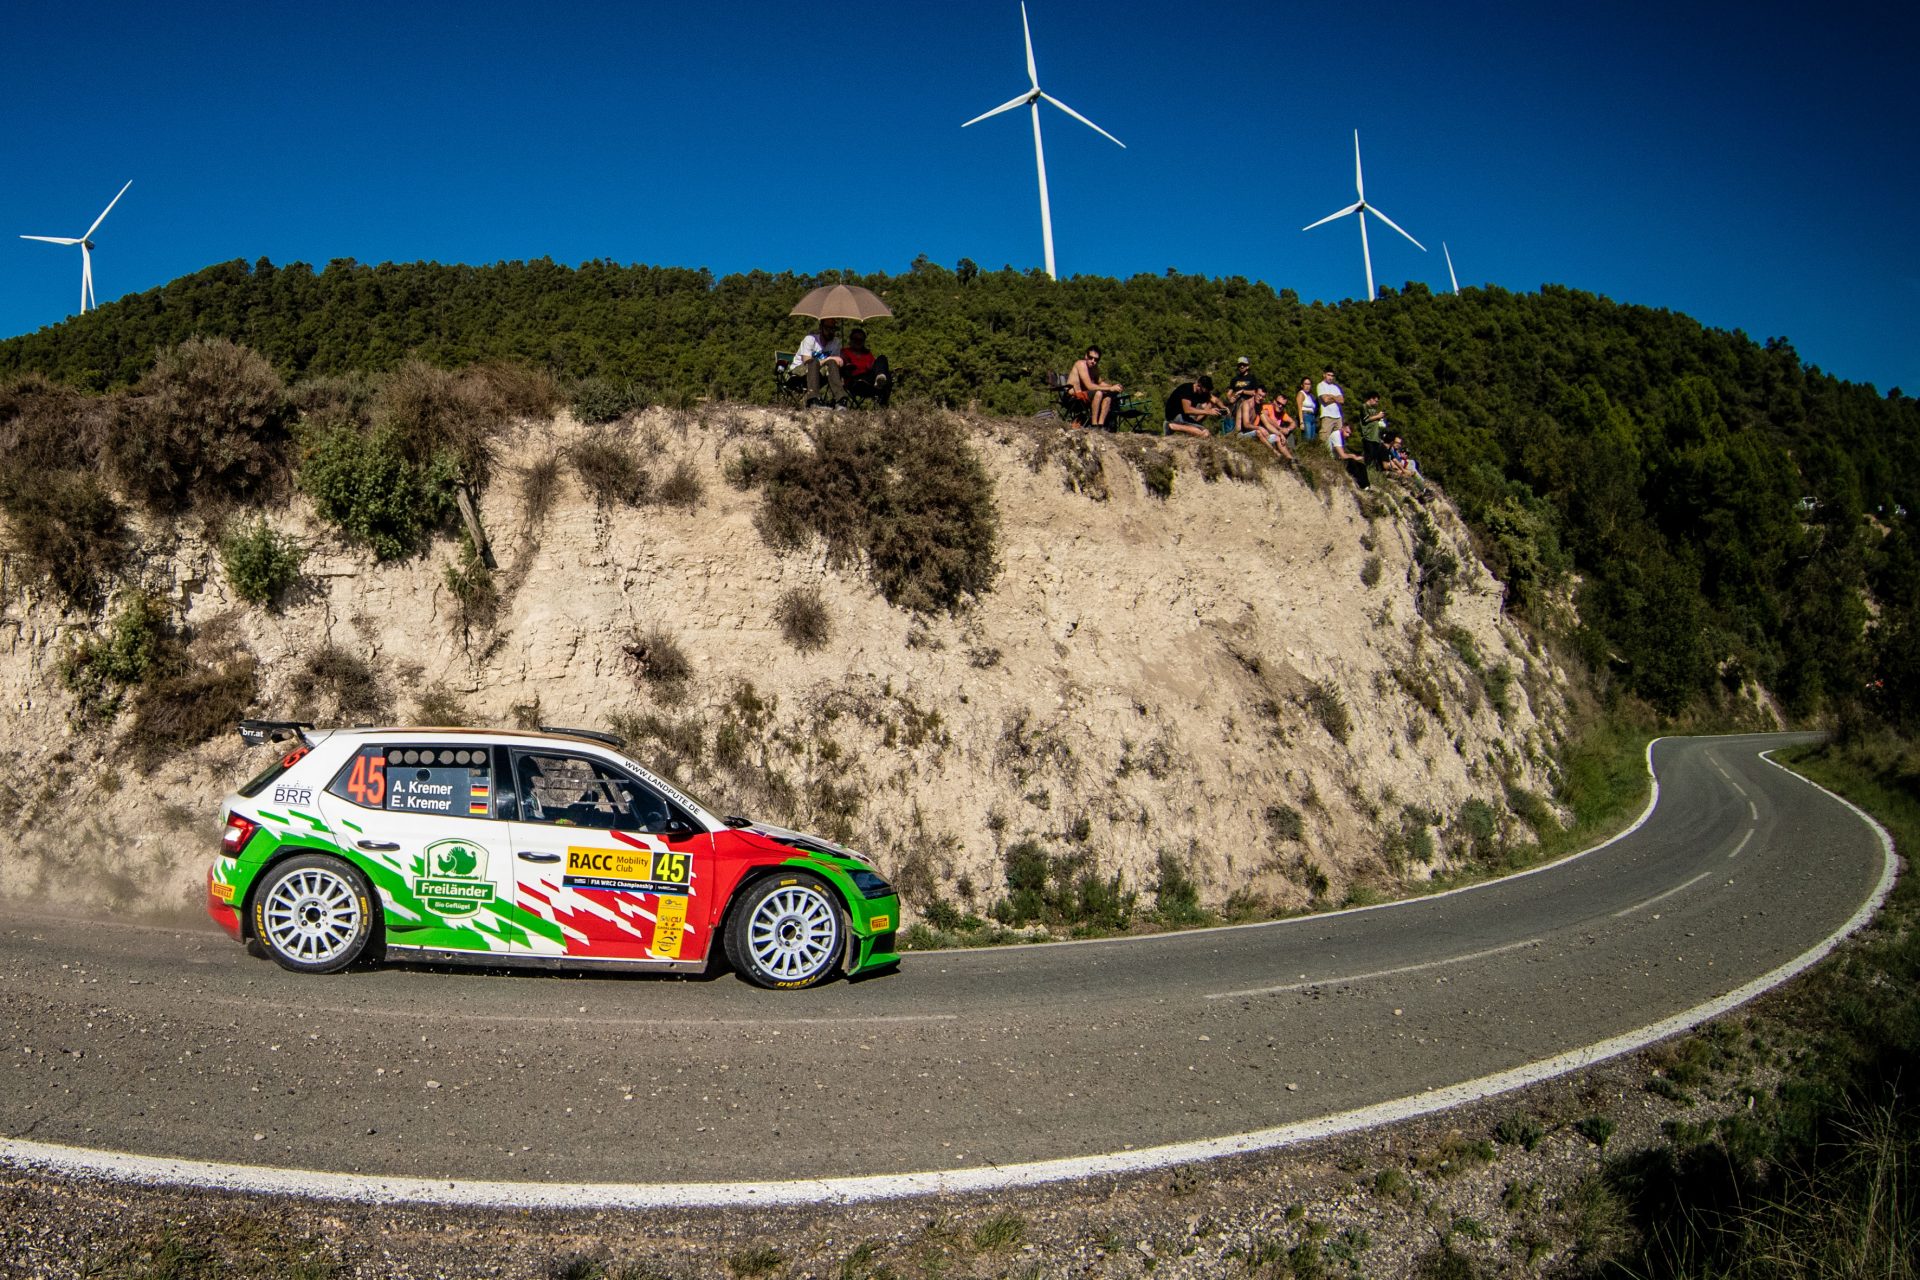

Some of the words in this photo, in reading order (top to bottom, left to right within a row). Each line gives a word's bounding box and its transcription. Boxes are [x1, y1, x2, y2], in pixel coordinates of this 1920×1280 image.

[242, 728, 264, 738] brr.at
[347, 755, 386, 804] 45
[393, 780, 406, 793] A.
[408, 781, 453, 795] Kremer
[625, 760, 701, 815] WWW.LANDPUTE.DE
[274, 788, 312, 804] BRR
[391, 795, 404, 808] E.
[407, 796, 452, 810] Kremer
[569, 853, 613, 871] RACC
[615, 864, 634, 873] Club
[616, 856, 649, 867] Mobility
[656, 853, 685, 883] 45
[421, 882, 488, 897] Freiländer
[590, 878, 601, 886] FIA
[617, 881, 654, 890] Championship
